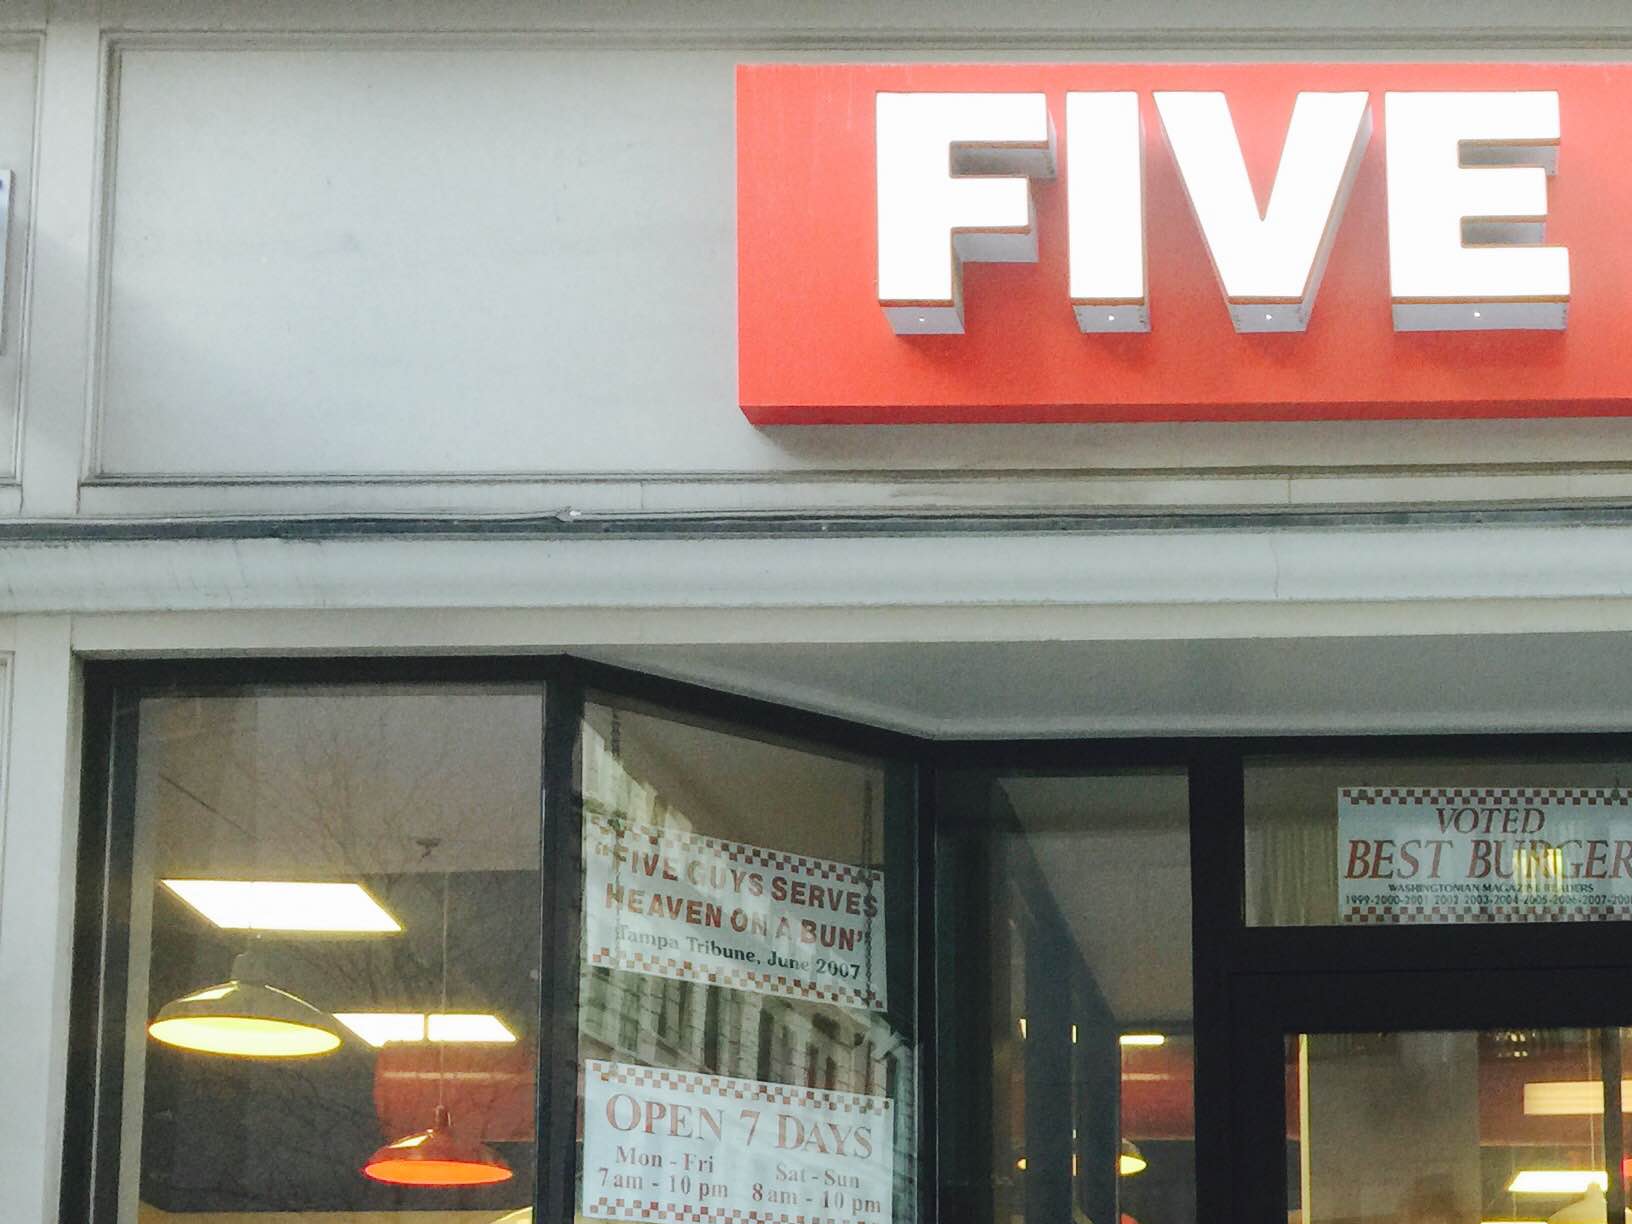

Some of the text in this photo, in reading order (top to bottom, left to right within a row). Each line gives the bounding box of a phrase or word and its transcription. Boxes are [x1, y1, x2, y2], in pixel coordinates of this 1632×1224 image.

[875, 88, 1570, 335] FIVE
[1436, 807, 1546, 834] VOTED
[1344, 839, 1453, 879] BEST
[686, 858, 765, 897] GUYS
[770, 874, 879, 919] SERVES
[605, 881, 723, 929] HEAVEN
[729, 907, 769, 938] ON
[775, 915, 792, 941] A
[617, 924, 861, 980] Tampa Tribune, June 2007
[605, 1093, 874, 1160] OPEN 7 DAYS
[616, 1145, 714, 1174] Mon Fri
[775, 1160, 861, 1190] Sat Sun
[598, 1167, 729, 1201] 7 am 10 pm
[752, 1183, 764, 1203] 8
[823, 1189, 845, 1210] 10
[852, 1196, 882, 1216] pm
